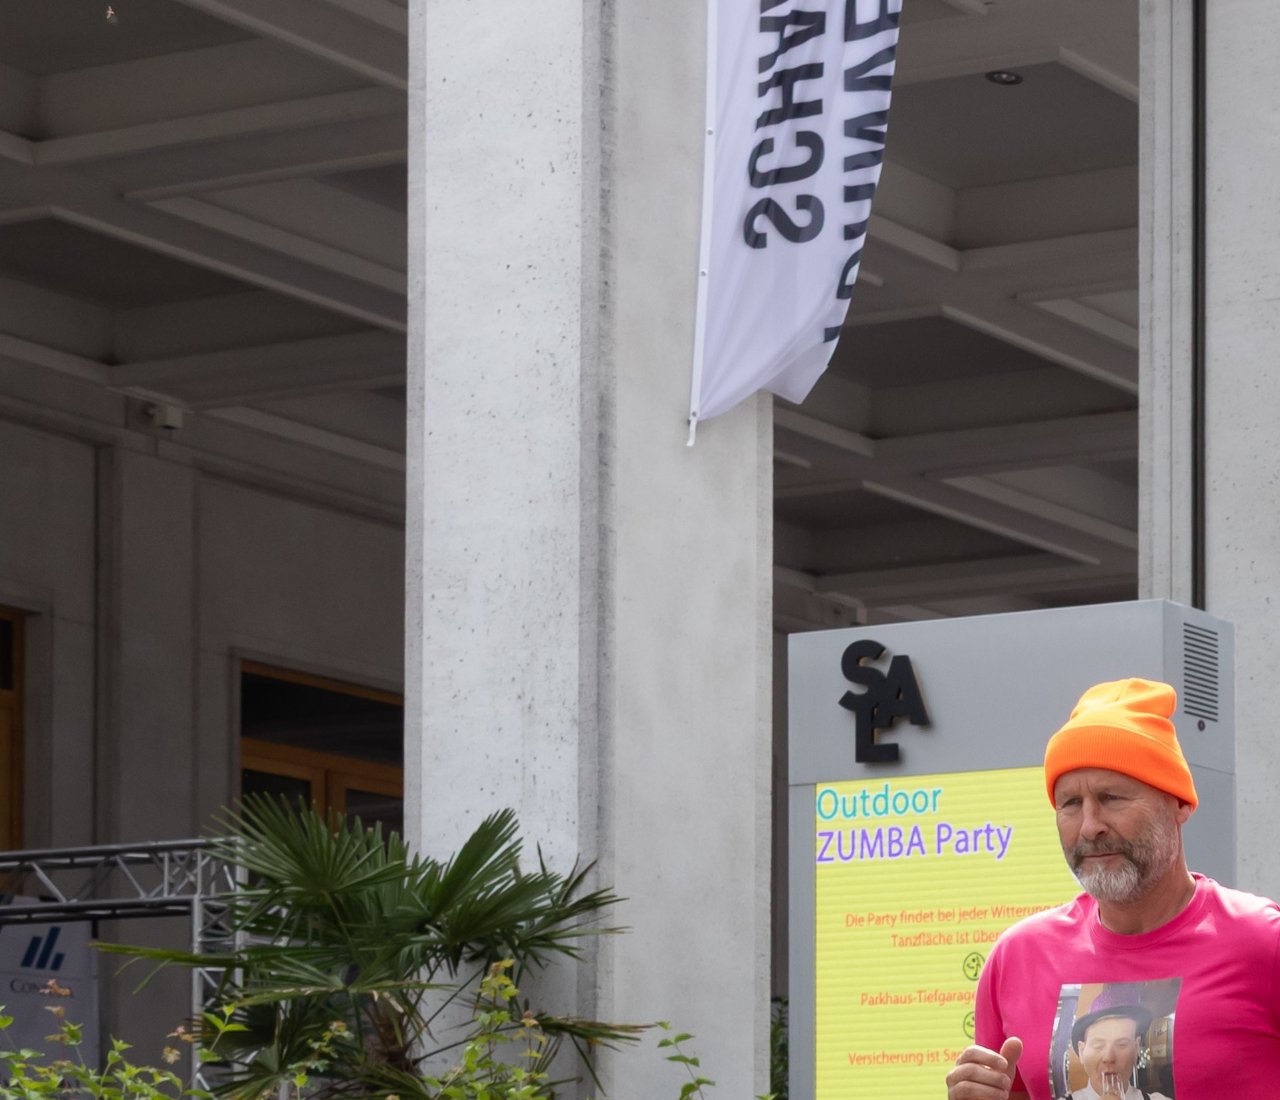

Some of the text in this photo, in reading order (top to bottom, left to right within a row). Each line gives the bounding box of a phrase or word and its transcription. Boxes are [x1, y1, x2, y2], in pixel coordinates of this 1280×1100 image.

[816, 784, 943, 820] Outdoor
[816, 823, 1013, 863] ZUMBA Party
[845, 913, 865, 928] Die
[867, 909, 897, 928] Party
[900, 907, 934, 925] findet
[937, 907, 955, 922] bei
[957, 905, 988, 925] jeder
[891, 929, 953, 948] Tanzfläche
[955, 928, 970, 945] ist
[848, 1050, 924, 1068] Versicherung
[926, 1049, 940, 1064] ist
